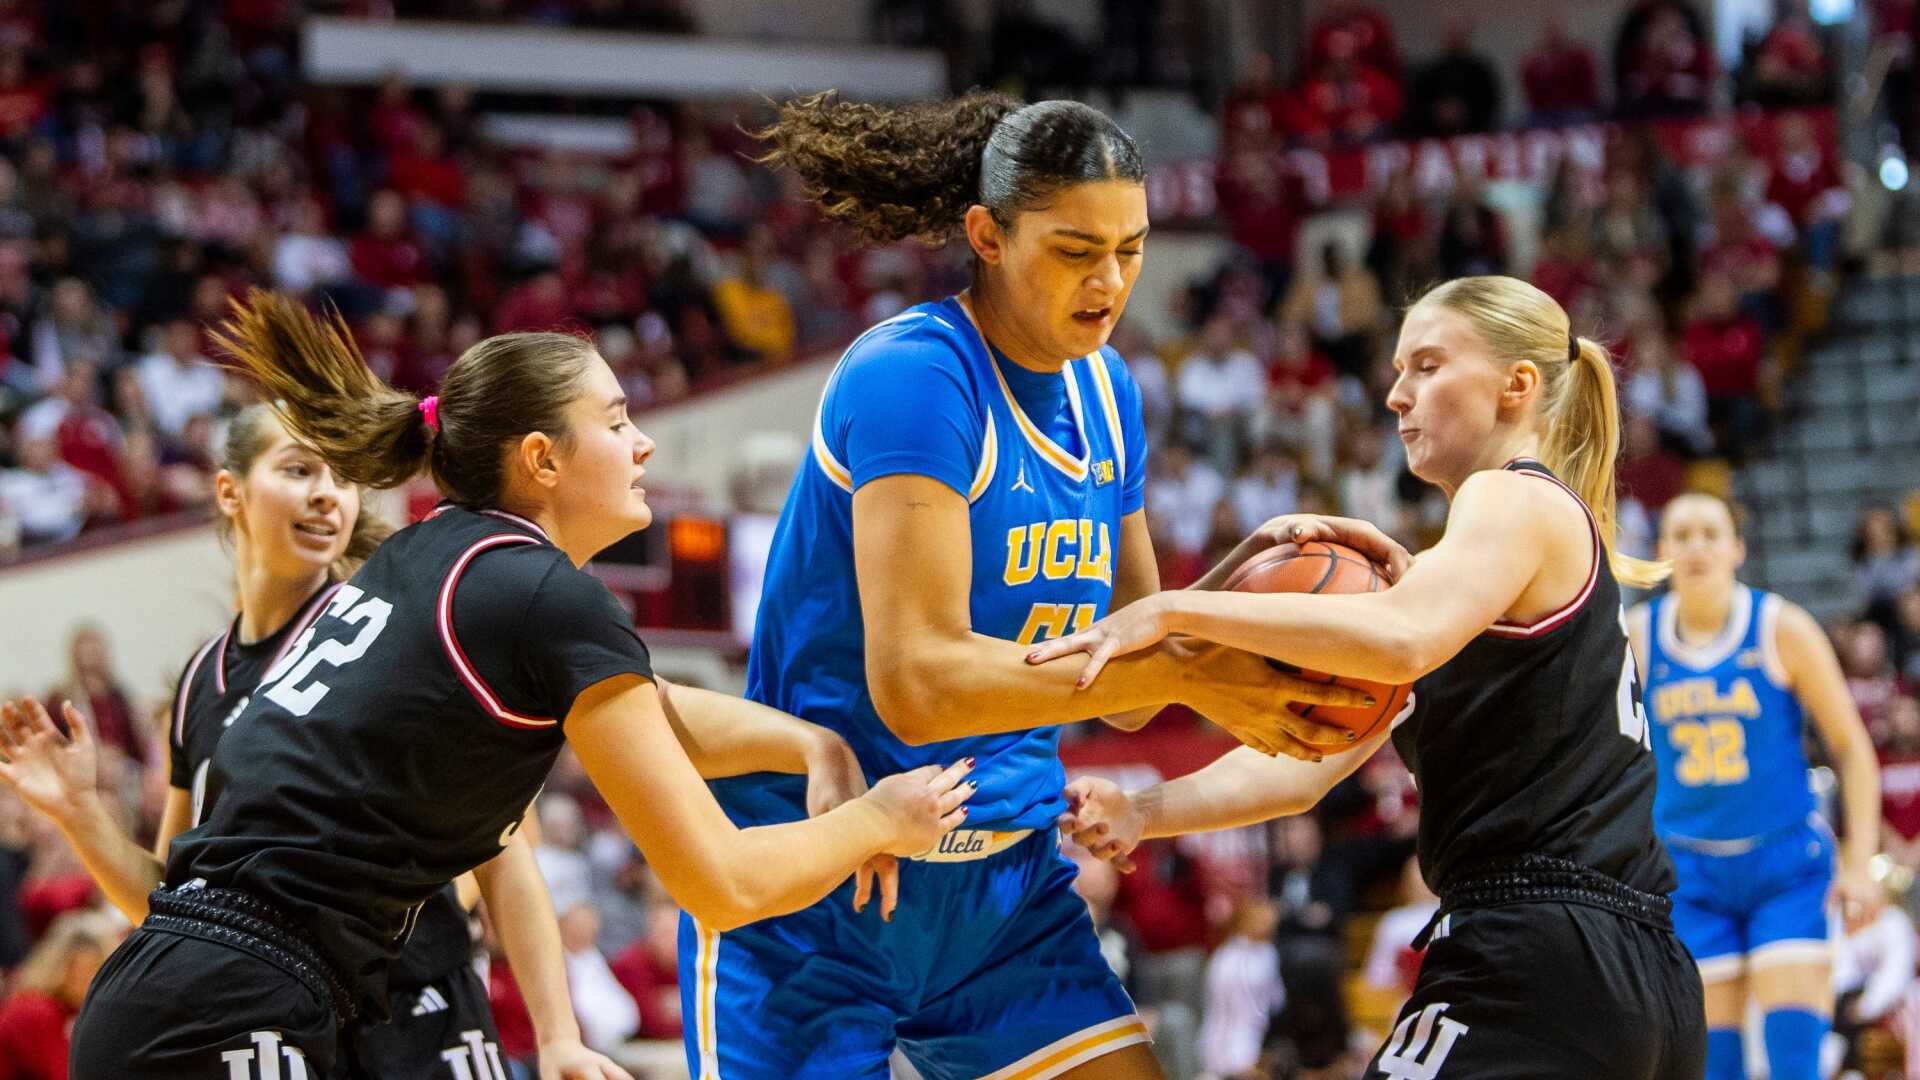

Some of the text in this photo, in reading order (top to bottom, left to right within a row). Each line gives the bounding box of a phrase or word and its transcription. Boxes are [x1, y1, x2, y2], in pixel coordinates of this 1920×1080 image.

[1003, 519, 1112, 587] UCLA
[1654, 678, 1761, 724] UCLA
[1671, 720, 1749, 787] 32
[938, 831, 984, 854] Ucla
